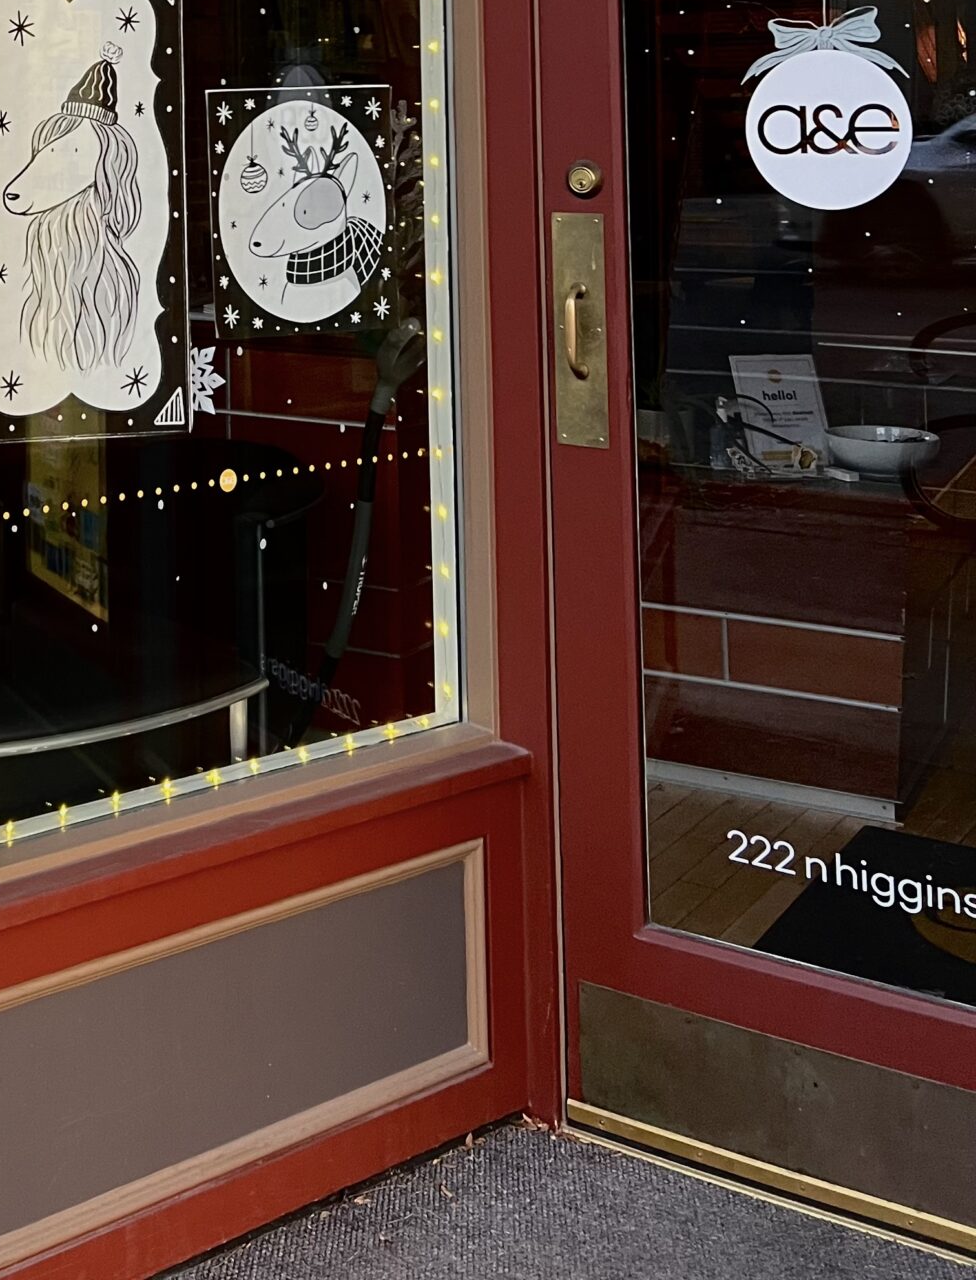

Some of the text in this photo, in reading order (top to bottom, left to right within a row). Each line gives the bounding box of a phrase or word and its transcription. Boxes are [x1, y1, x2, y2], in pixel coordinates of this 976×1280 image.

[757, 103, 900, 155] a&e
[726, 829, 976, 919] 222 n higgins
